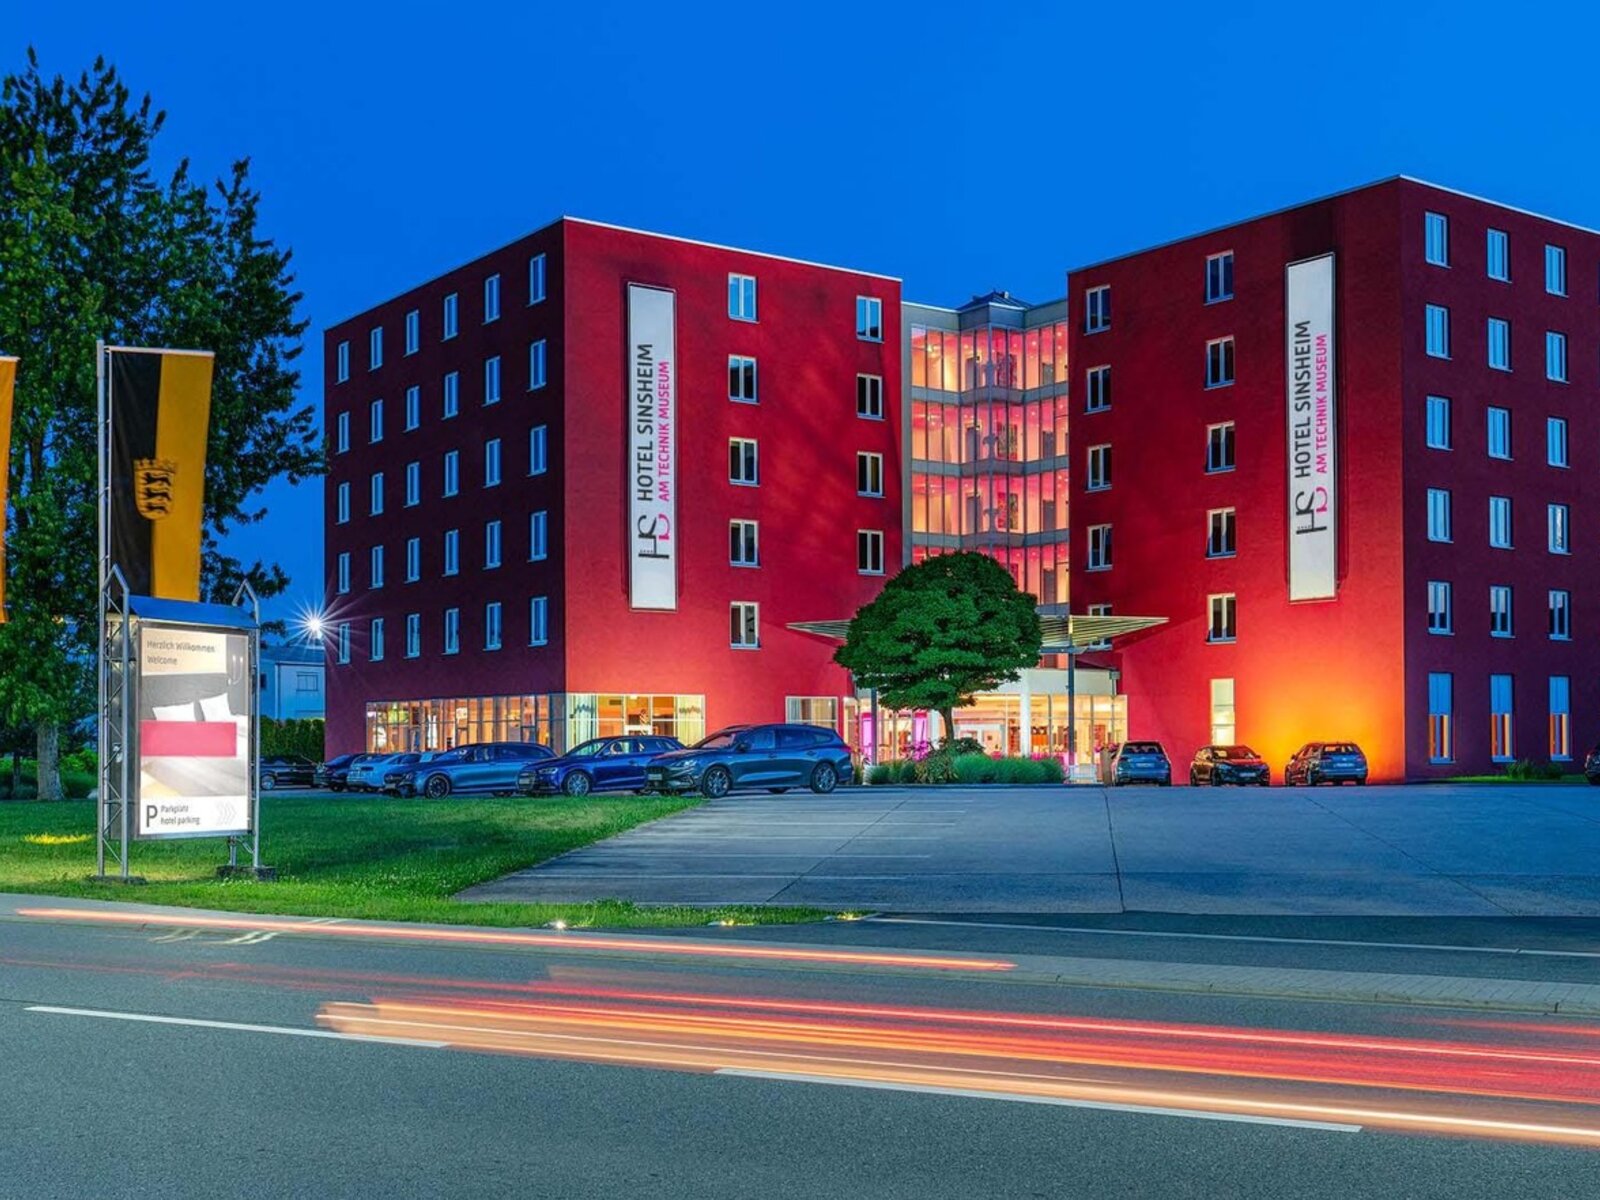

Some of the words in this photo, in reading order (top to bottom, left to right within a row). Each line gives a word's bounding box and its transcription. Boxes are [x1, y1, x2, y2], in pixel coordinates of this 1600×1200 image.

[637, 344, 653, 435] SINSHEIM
[658, 361, 670, 419] MUSEUM
[1295, 320, 1311, 412] SINSHEIM
[1316, 334, 1327, 392] MUSEUM
[658, 423, 670, 477] TECHNIK
[1295, 417, 1311, 478] HOTEL
[1316, 396, 1327, 450] TECHNIK
[637, 441, 653, 502] HOTEL
[1316, 452, 1327, 474] AM
[658, 481, 670, 502] AM
[147, 641, 174, 649] Herzlich
[176, 642, 215, 653] Willkommen
[147, 656, 177, 665] Welcome
[146, 805, 158, 828] P
[160, 816, 177, 825] hotel
[177, 817, 200, 826] parking
